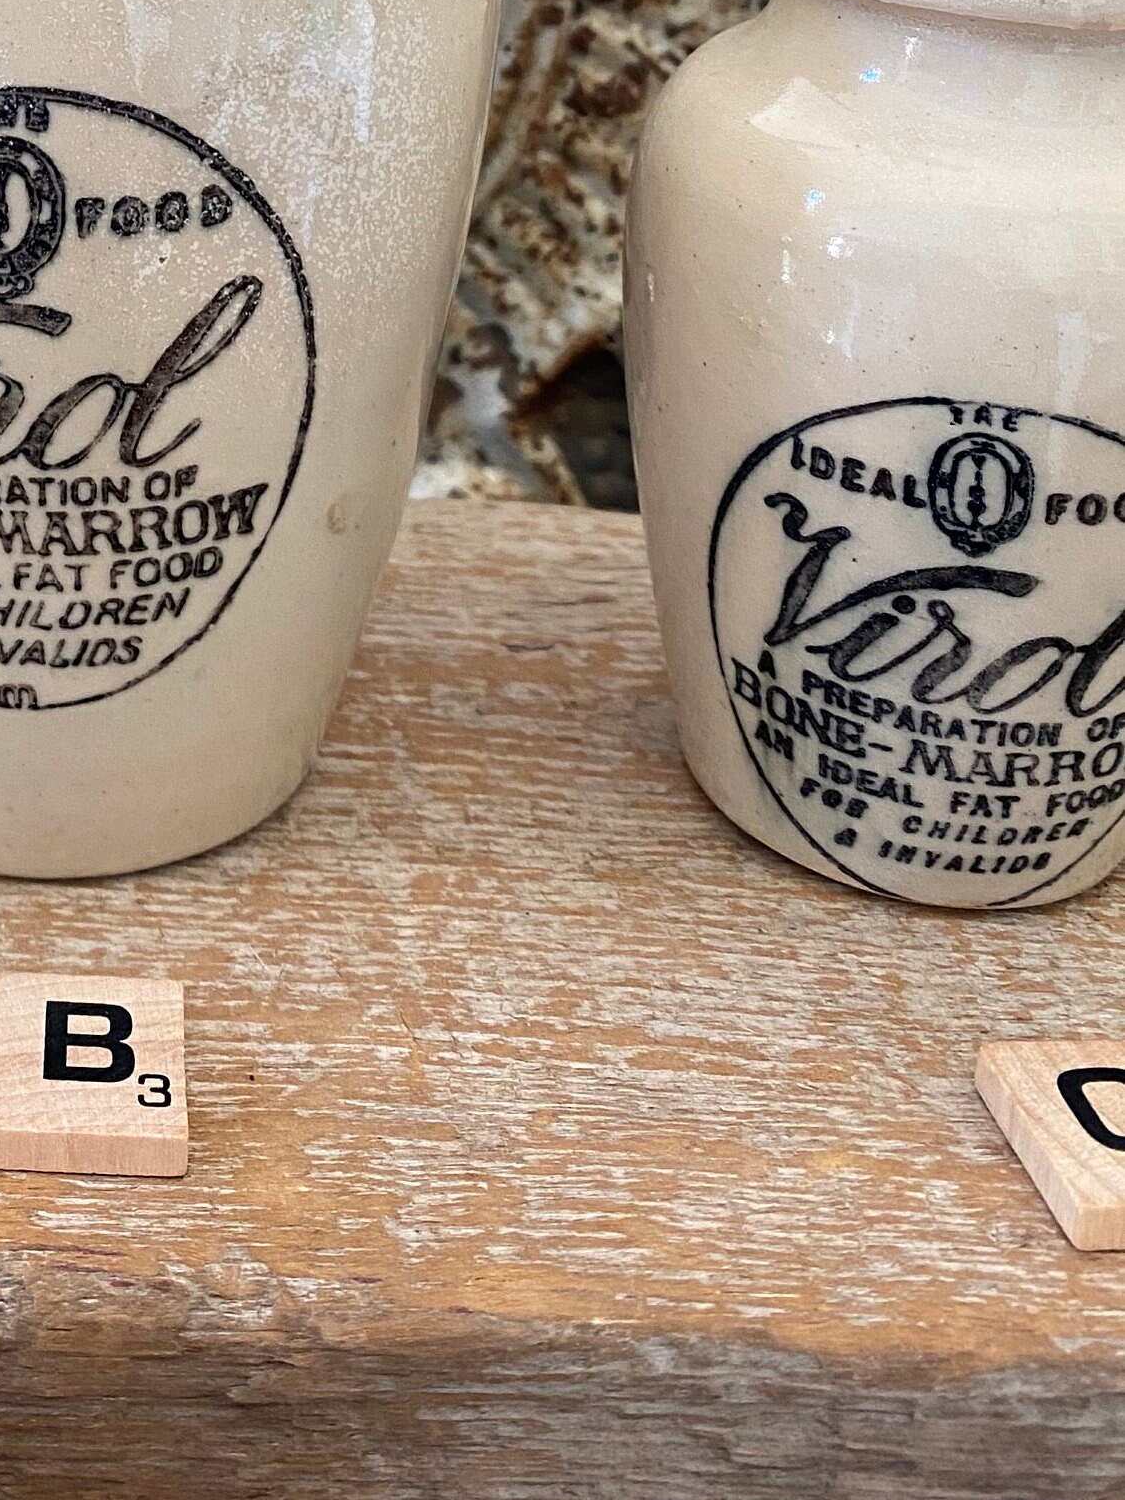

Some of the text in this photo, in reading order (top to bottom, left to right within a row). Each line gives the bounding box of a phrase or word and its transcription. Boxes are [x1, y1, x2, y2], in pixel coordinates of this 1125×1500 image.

[74, 183, 235, 238] FOOD
[143, 464, 200, 501] OF
[788, 434, 927, 509] IDEAL
[13, 560, 91, 592] FAT
[109, 545, 224, 590] FOOD
[757, 650, 776, 679] A
[802, 669, 1063, 748] PREPARATION
[755, 719, 794, 761] AN
[818, 753, 925, 808] IDEAL
[949, 791, 1021, 820] FAT
[800, 777, 1091, 846] FOR CHILDREN
[42, 1000, 172, 1108] B 3
